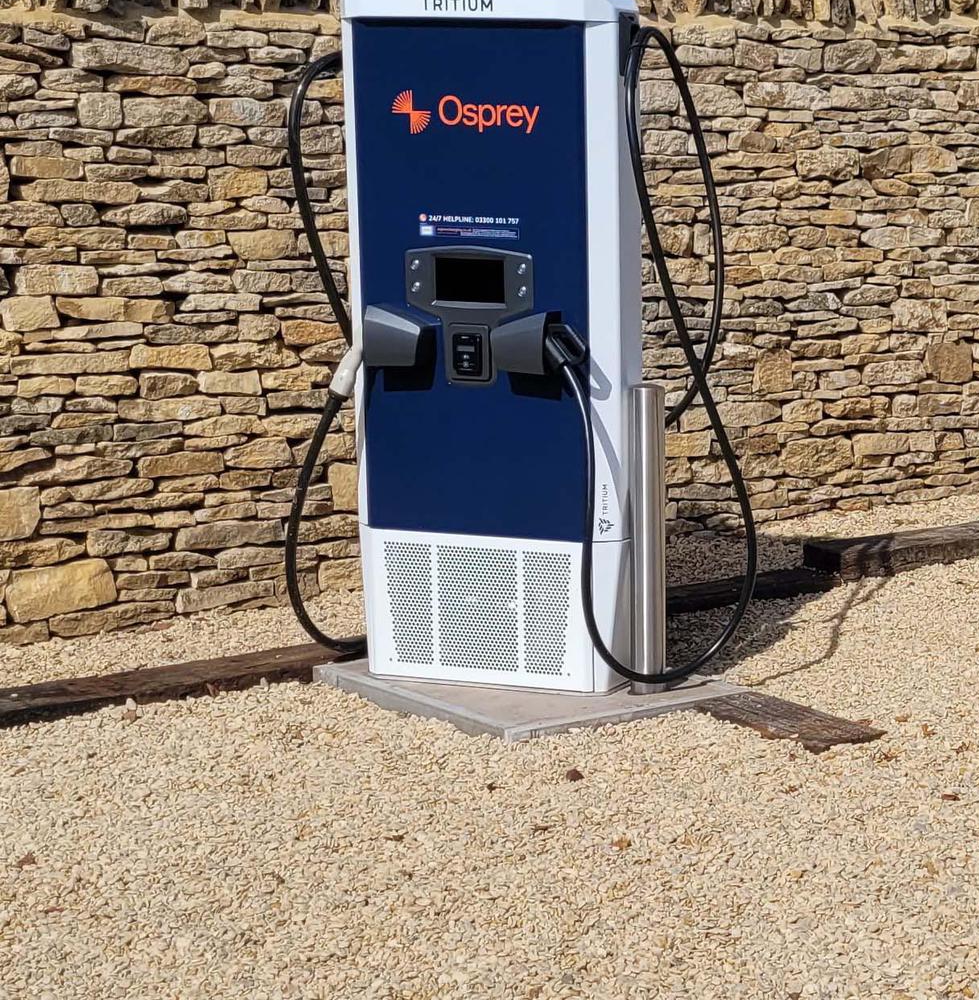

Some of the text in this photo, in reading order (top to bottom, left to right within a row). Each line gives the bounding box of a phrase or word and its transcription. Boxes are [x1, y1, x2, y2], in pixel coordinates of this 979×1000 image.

[438, 95, 540, 134] Osprey
[428, 214, 442, 222] 24/7
[443, 215, 474, 223] HELPLINE:
[475, 216, 494, 224] 03300
[507, 217, 519, 225] 757
[601, 483, 609, 516] TRITIUM
